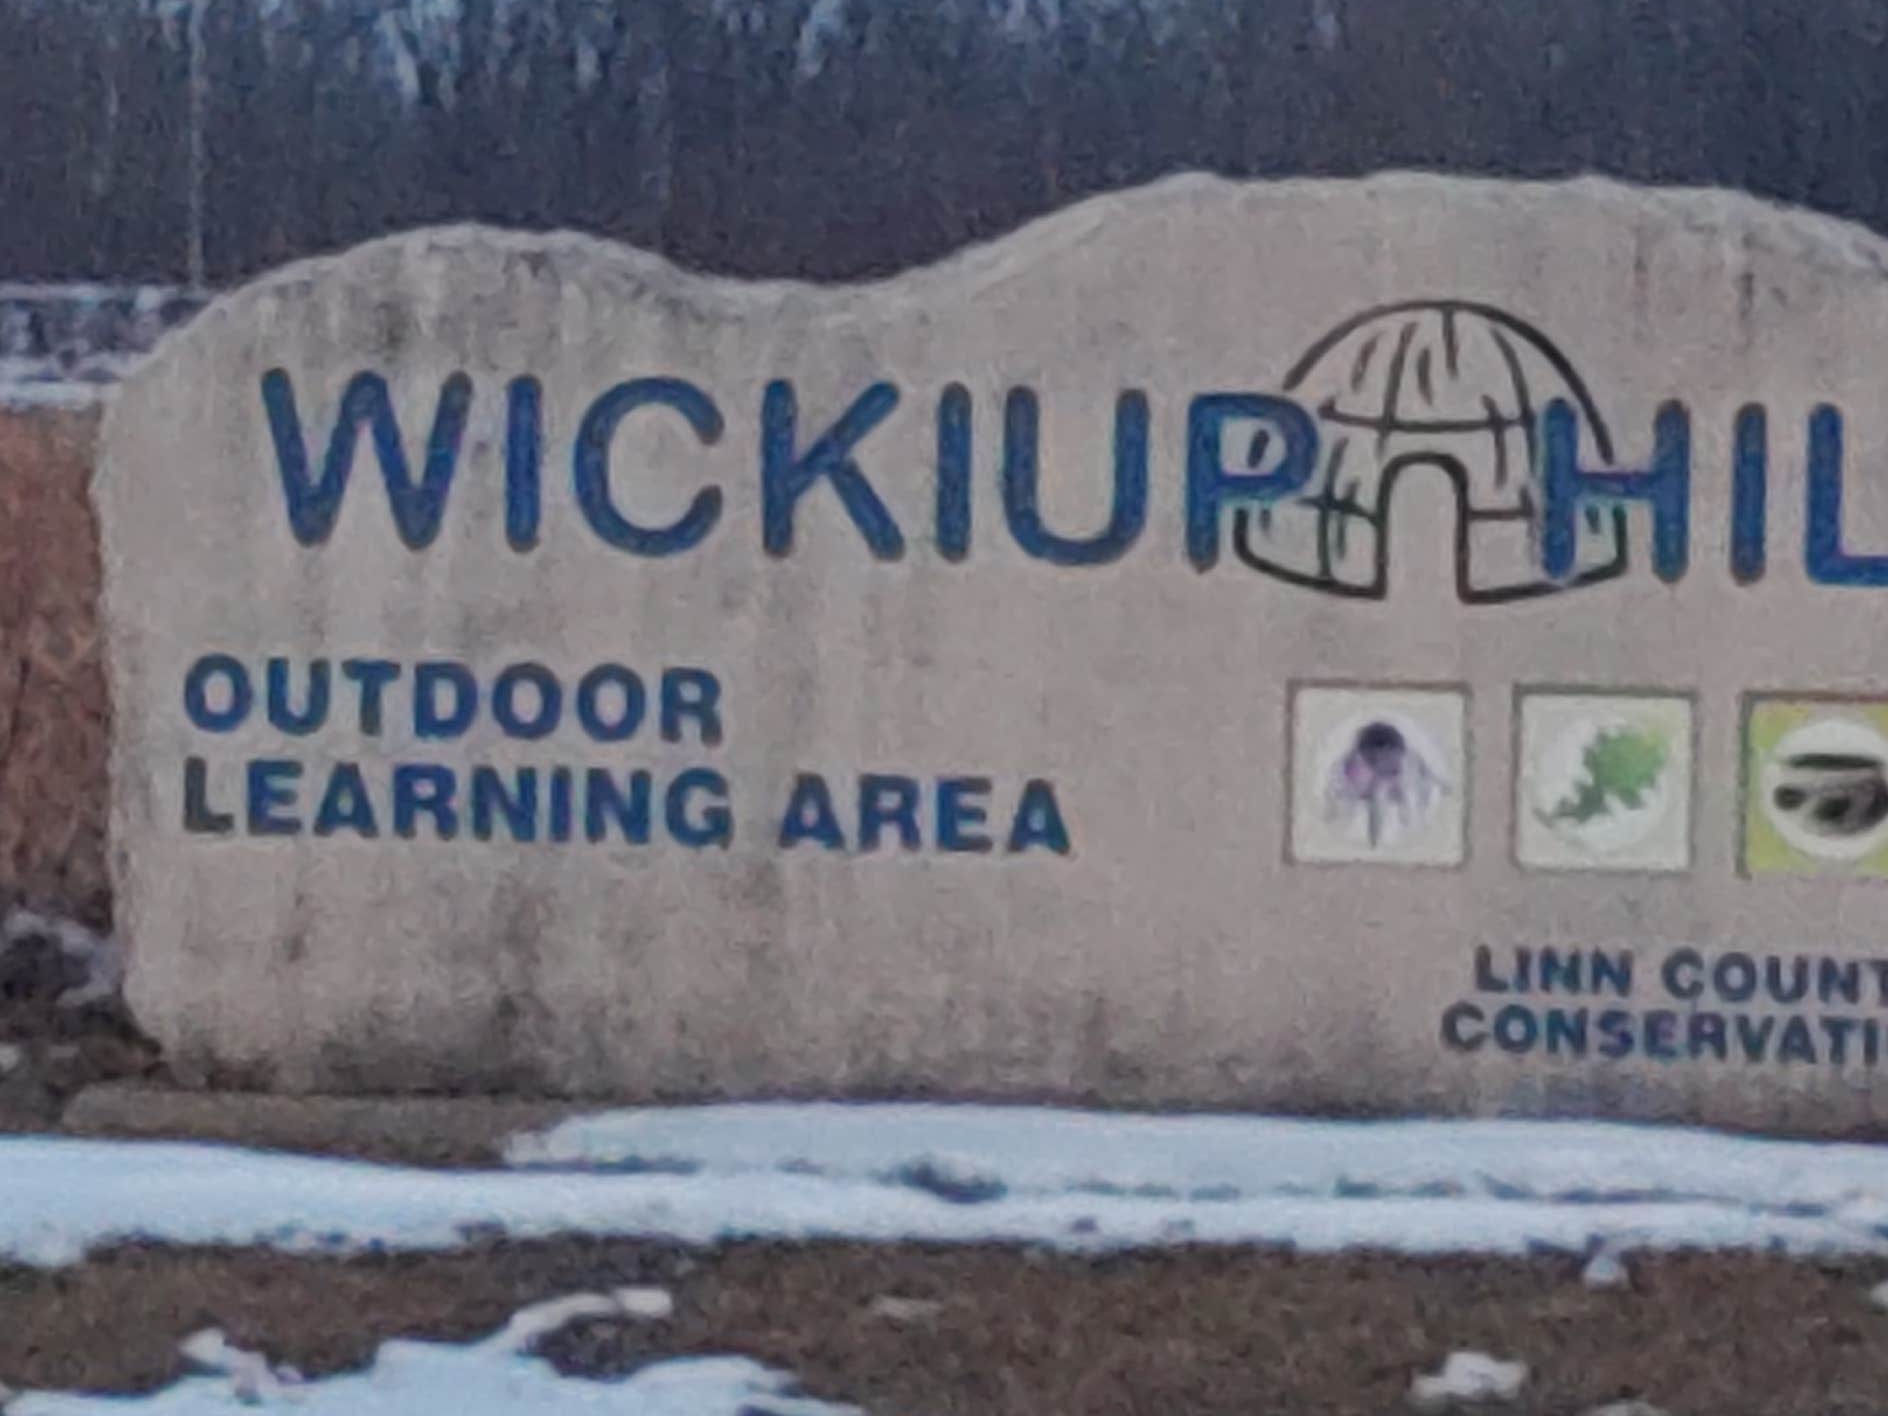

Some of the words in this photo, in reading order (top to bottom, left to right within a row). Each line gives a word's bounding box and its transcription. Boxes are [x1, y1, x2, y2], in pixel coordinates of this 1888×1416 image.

[260, 368, 1319, 574] WICKIUP
[183, 654, 724, 746] OUTDOOR
[182, 757, 732, 849] LEARNING
[778, 772, 1072, 856] AREA
[1474, 945, 1633, 997] LINN
